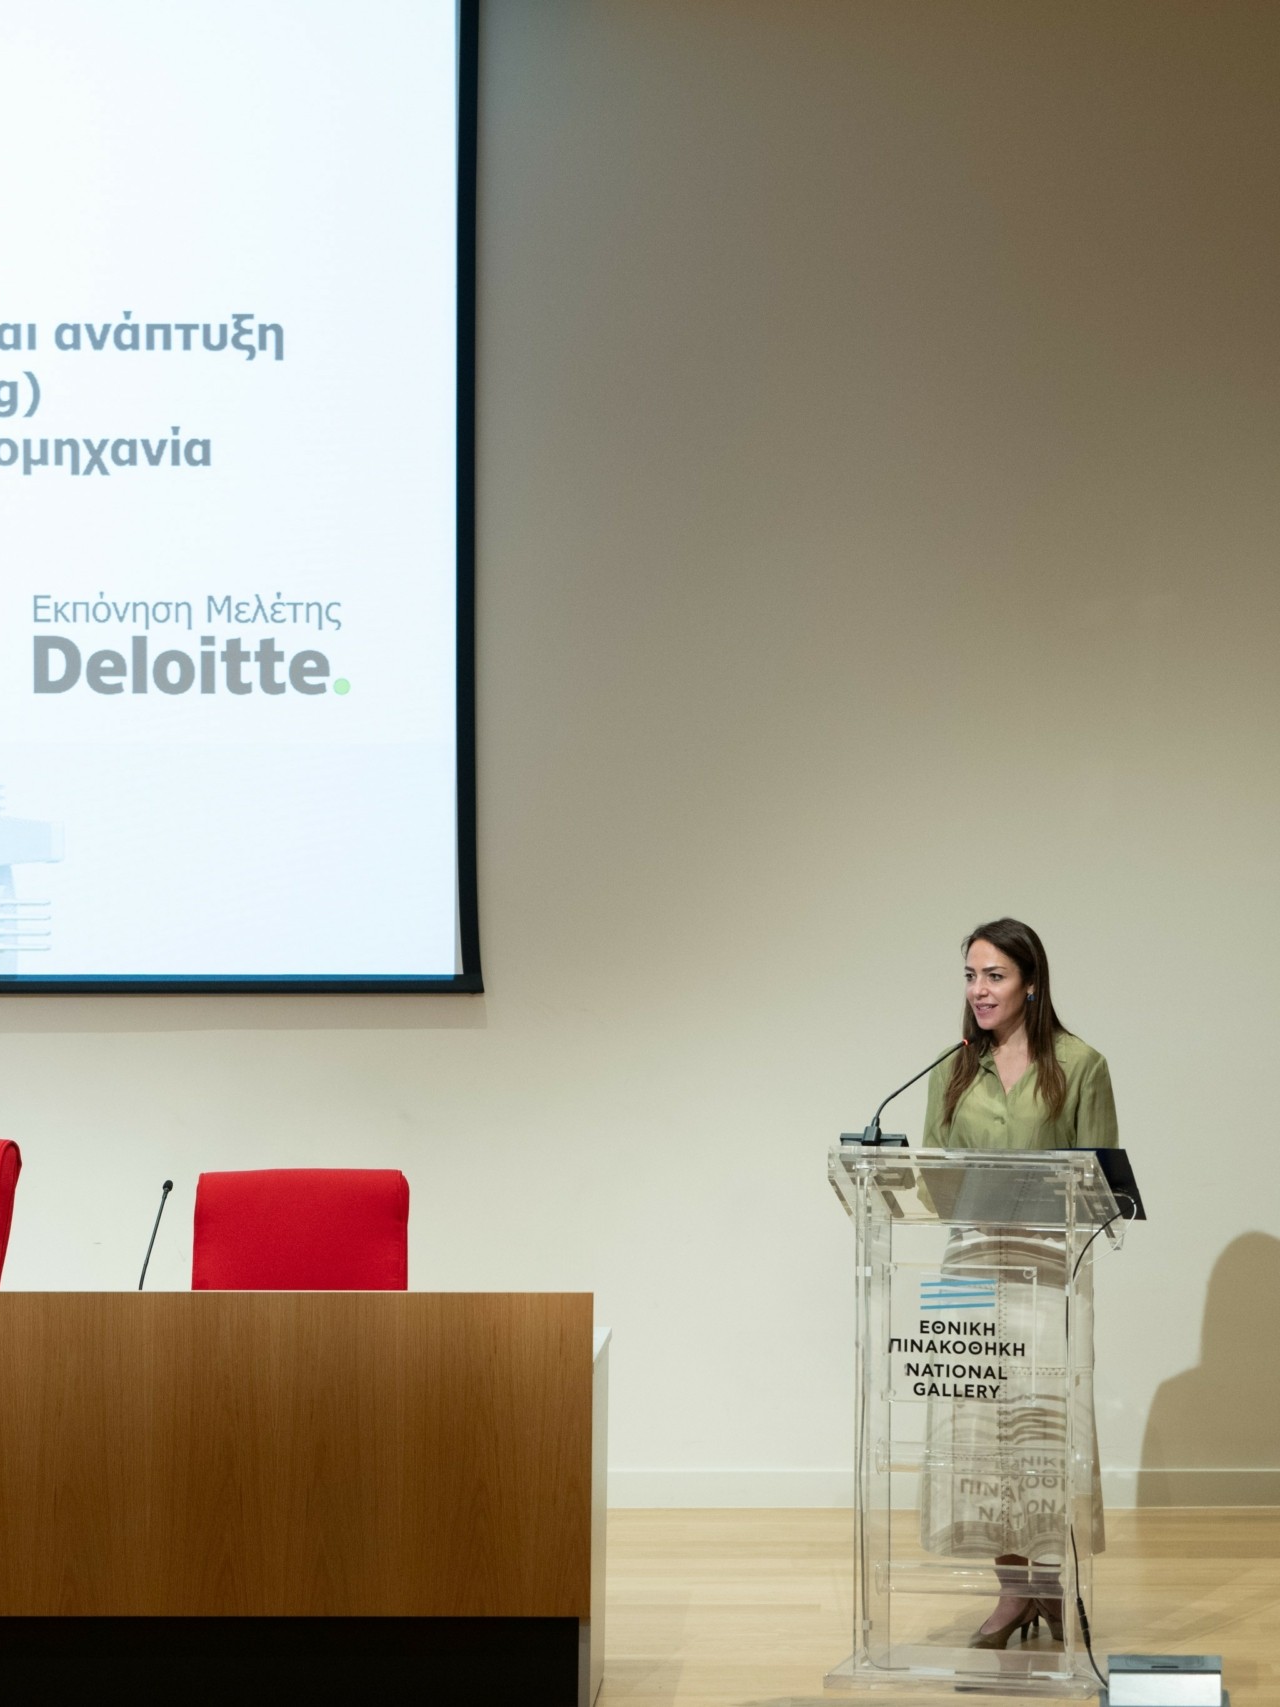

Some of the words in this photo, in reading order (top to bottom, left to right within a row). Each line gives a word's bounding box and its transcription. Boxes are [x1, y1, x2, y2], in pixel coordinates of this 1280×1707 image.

[54, 310, 284, 361] ανάπτυξη
[33, 591, 192, 630] Εκπόνηση
[207, 591, 342, 631] Μελέτης
[919, 1320, 996, 1337] ΕΘΝΙΚΗ
[888, 1338, 1026, 1357] ΠΙΝΑΚΟΘΗΚΗ
[904, 1362, 1009, 1381] NATIONAL
[912, 1382, 1001, 1399] GALLERY
